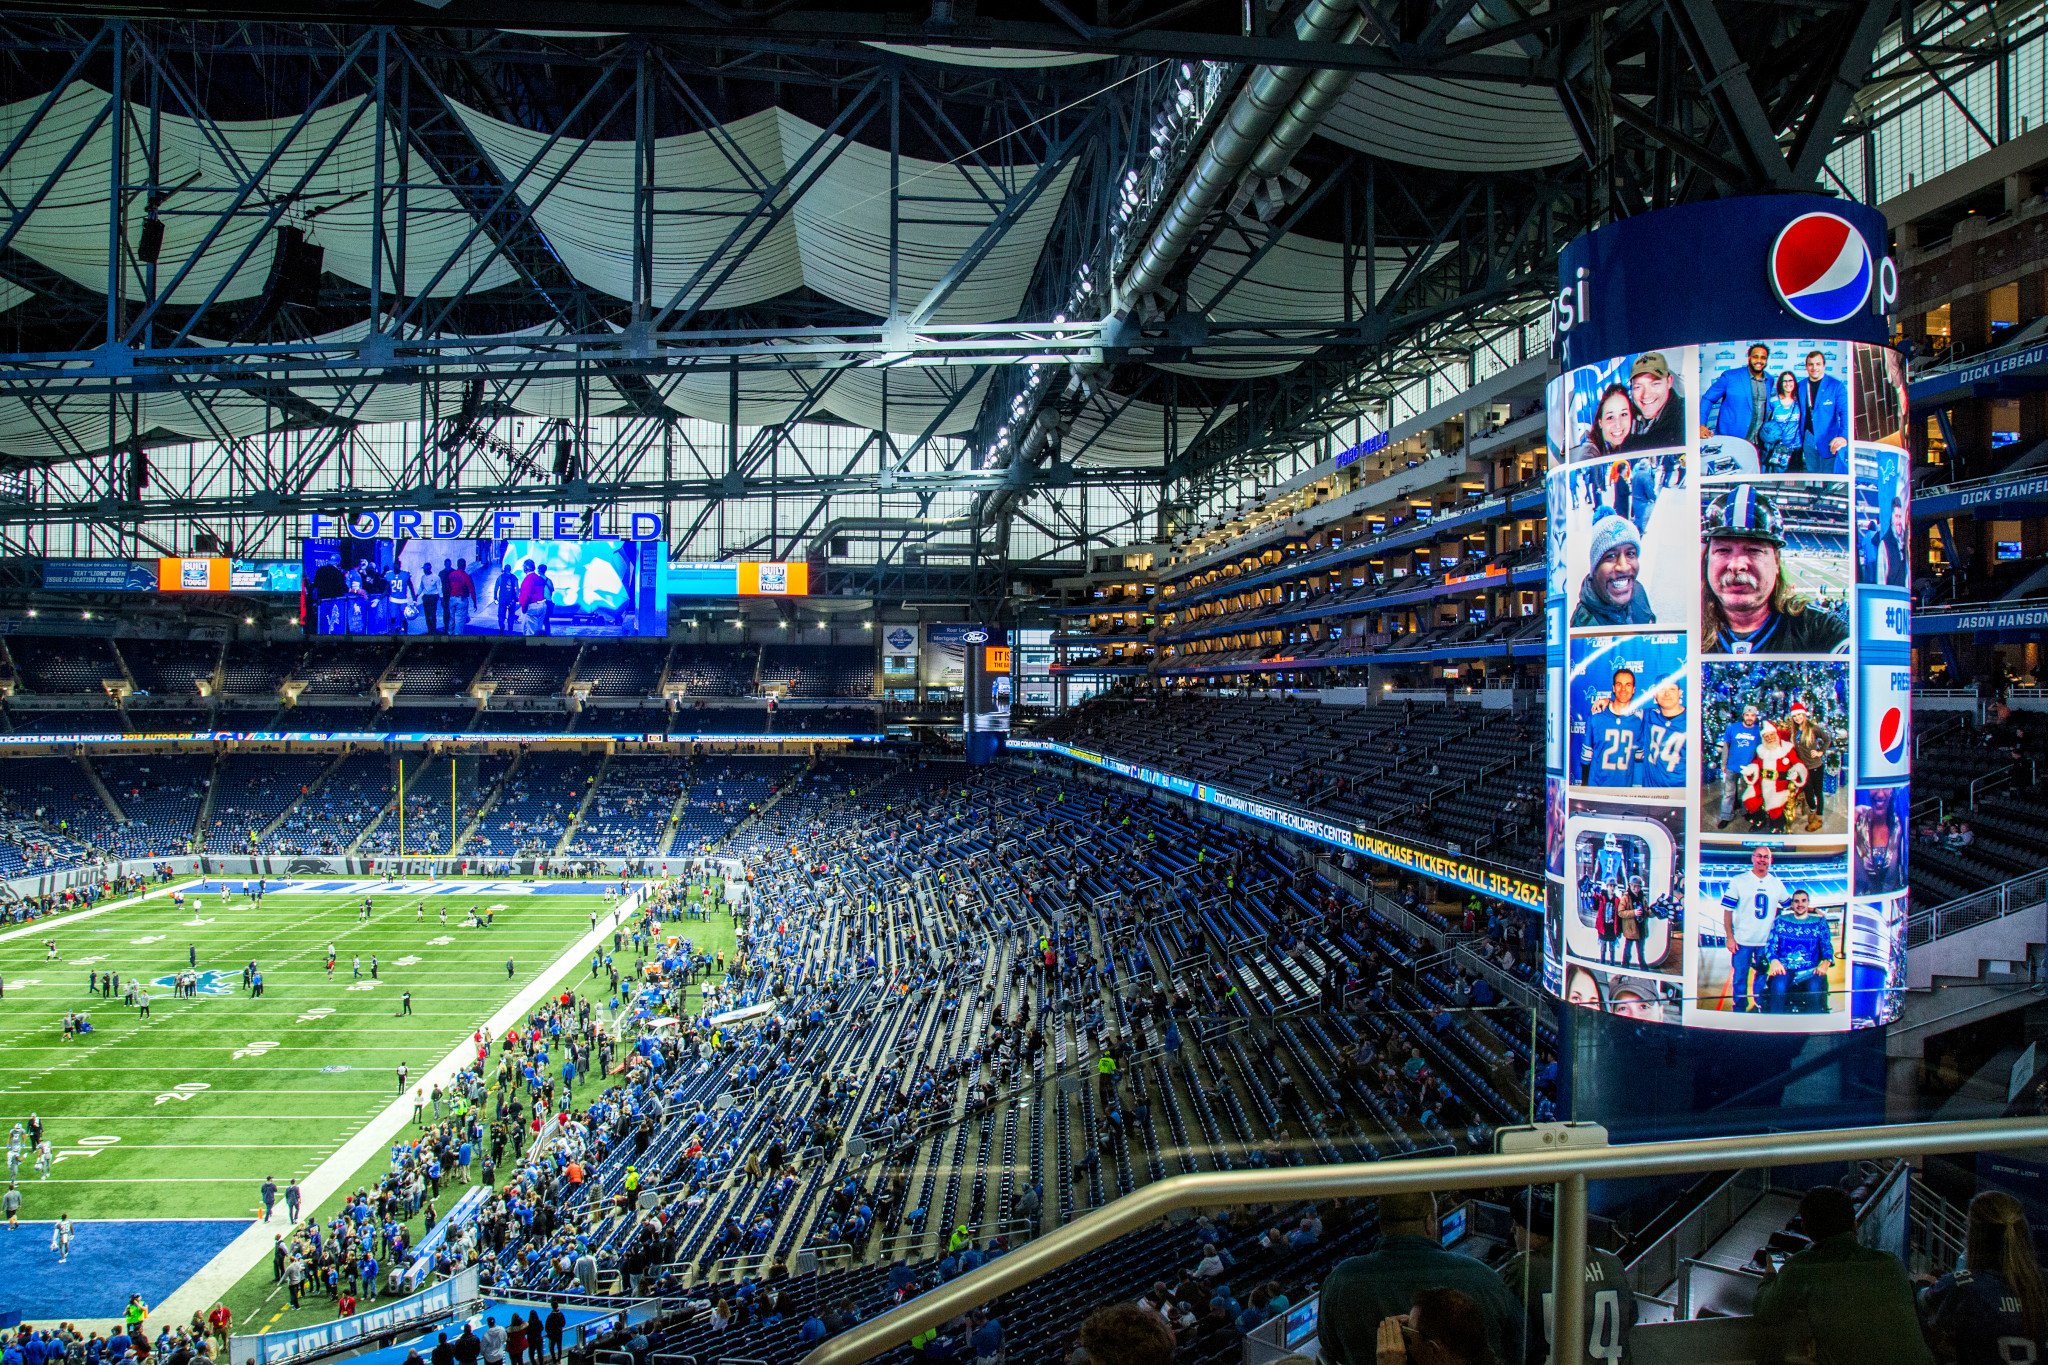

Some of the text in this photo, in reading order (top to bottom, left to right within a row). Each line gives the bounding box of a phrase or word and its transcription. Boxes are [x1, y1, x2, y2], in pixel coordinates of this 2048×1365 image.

[1960, 349, 2043, 384] DICK LEBEAU
[1336, 430, 1388, 469] FORD FIELD
[1961, 490, 1991, 506] DICK
[310, 510, 664, 542] FORD FIELD
[184, 562, 207, 570] BUILT
[762, 566, 784, 575] BUILT
[391, 580, 403, 592] 24
[1957, 611, 2048, 629] JASON HANSON
[965, 632, 986, 642] Ford
[994, 651, 1003, 661] IT
[1602, 729, 1634, 771] 23
[1648, 724, 1687, 773] 84
[1214, 791, 1227, 804] OTOR
[1227, 795, 1248, 812] COMPANY
[1248, 801, 1254, 814] TO
[1256, 803, 1276, 821] BENEFIT
[1276, 809, 1288, 825] THE
[1288, 813, 1324, 837] CHILDREN'S
[1324, 824, 1353, 847] CENTER.
[1353, 833, 1365, 851] TO
[1366, 838, 1413, 866] PURCHASE
[1414, 851, 1458, 880] TICKETS
[1458, 864, 1488, 890] CALL
[374, 860, 456, 875] DETROIT
[1607, 857, 1614, 874] 9
[66, 865, 109, 888] LIONS
[1754, 893, 1769, 920] 9
[298, 1008, 337, 1020] 40
[233, 1041, 281, 1057] 30
[154, 1082, 212, 1101] 20
[55, 1135, 122, 1158] 10
